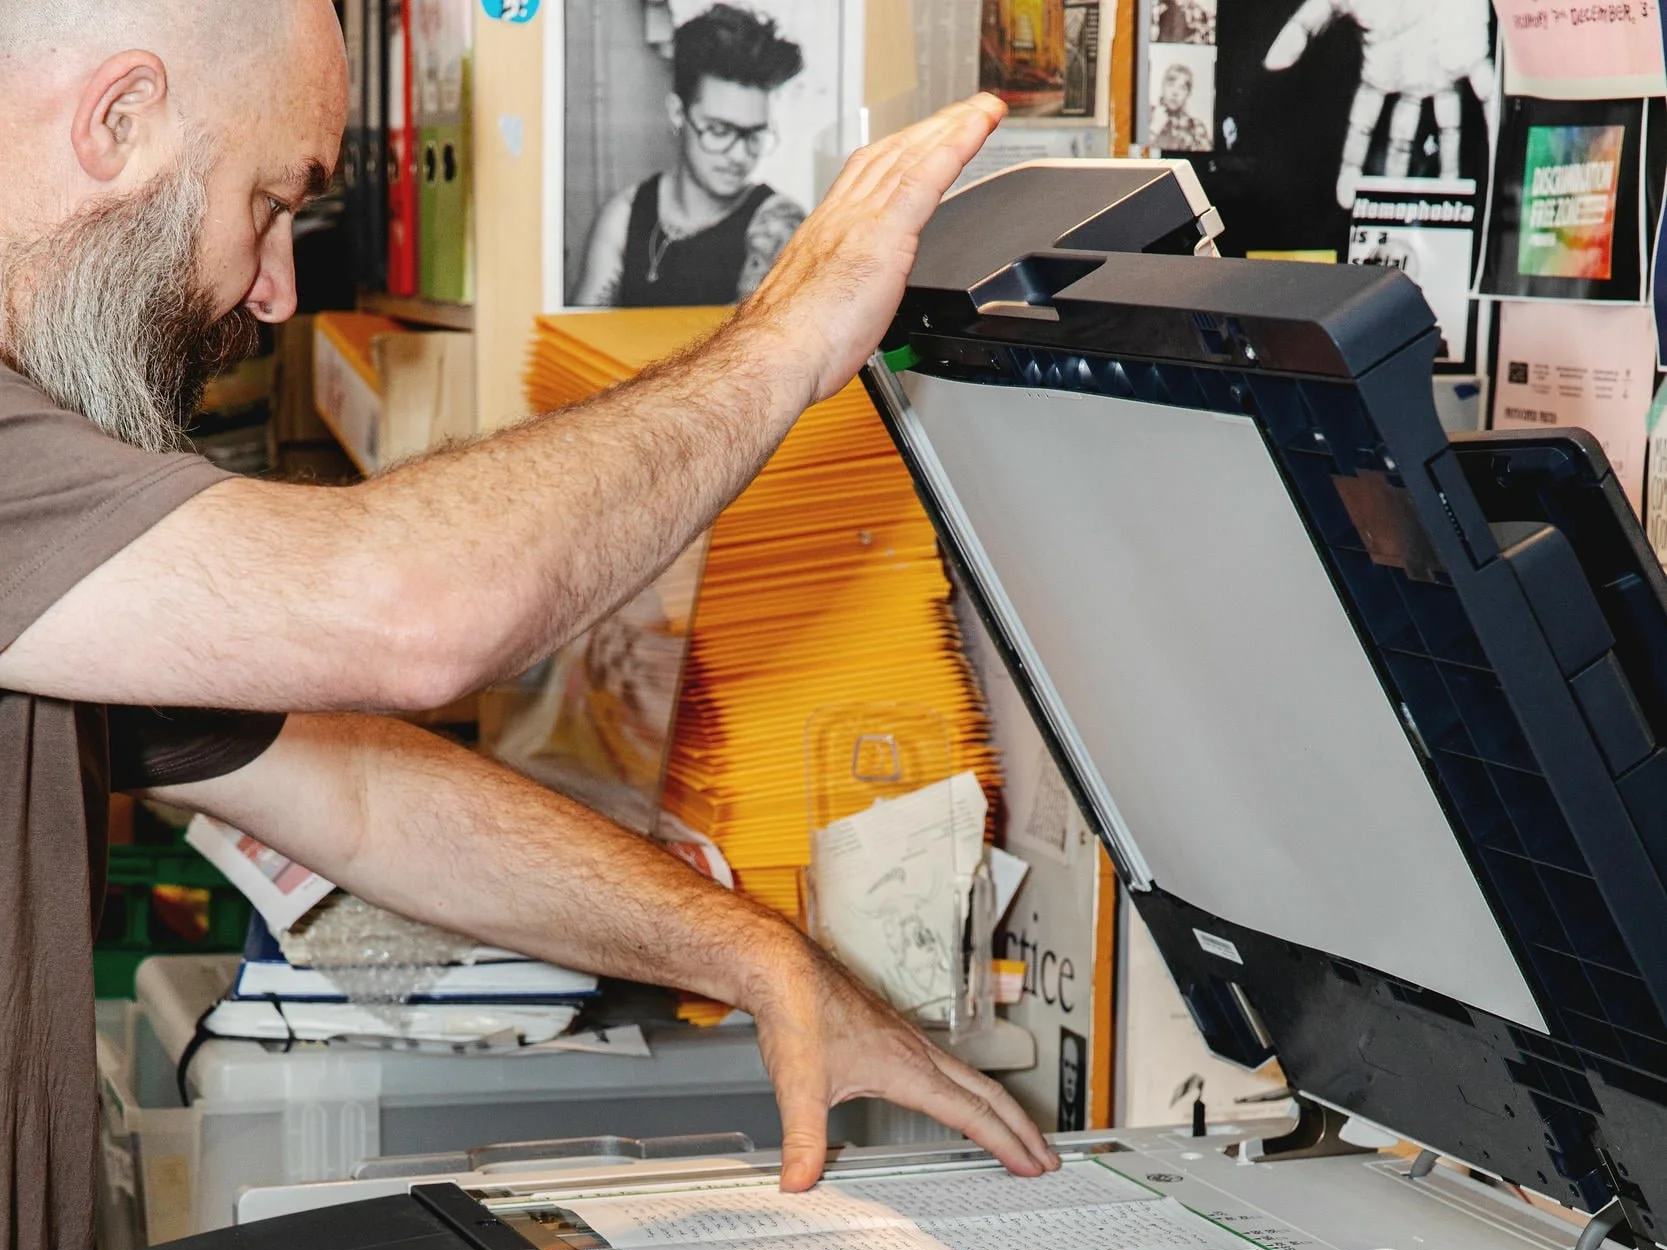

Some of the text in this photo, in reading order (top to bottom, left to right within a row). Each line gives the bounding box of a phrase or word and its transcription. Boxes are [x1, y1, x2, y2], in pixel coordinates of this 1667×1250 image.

[1352, 198, 1474, 223] Homophobia
[1351, 227, 1387, 244] is a
